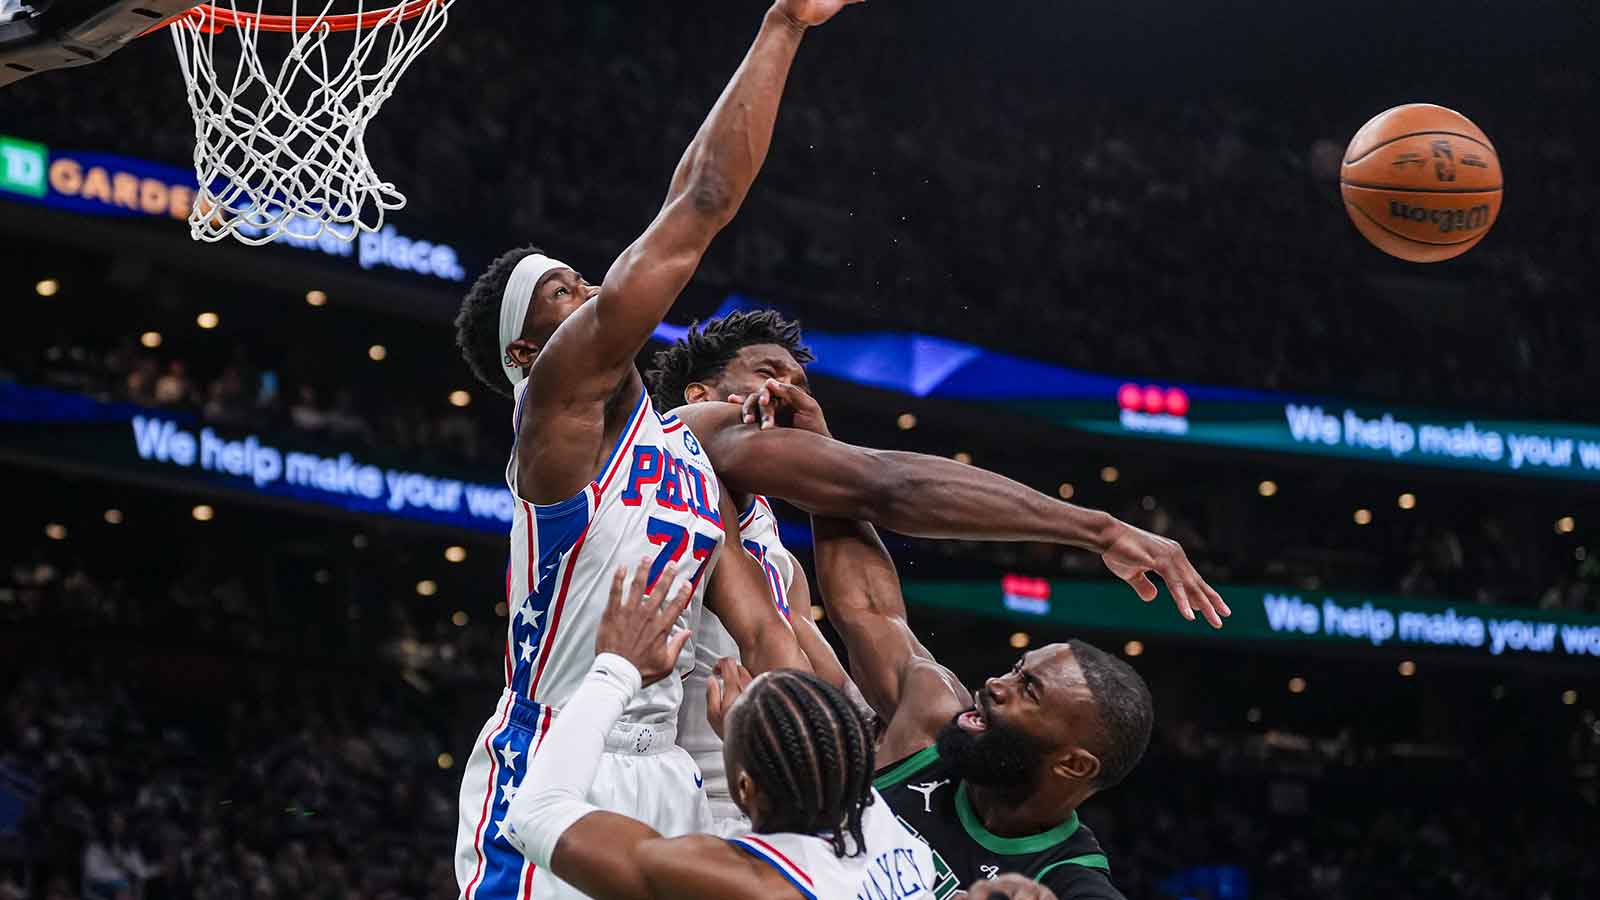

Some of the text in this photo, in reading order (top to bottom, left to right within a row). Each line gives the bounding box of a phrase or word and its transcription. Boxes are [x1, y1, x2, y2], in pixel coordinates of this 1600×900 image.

[2, 144, 45, 187] TD
[358, 223, 465, 281] place.
[132, 415, 197, 466] We
[200, 427, 283, 488] help
[285, 452, 384, 499] make
[385, 469, 464, 511] your
[1285, 403, 1341, 446] We
[1343, 408, 1415, 458] help
[1418, 420, 1503, 462] make
[1506, 432, 1573, 469] your
[643, 516, 718, 609] 77
[1263, 593, 1320, 635] We
[1322, 597, 1395, 647] help
[1398, 608, 1485, 648] make
[1487, 618, 1556, 656] your
